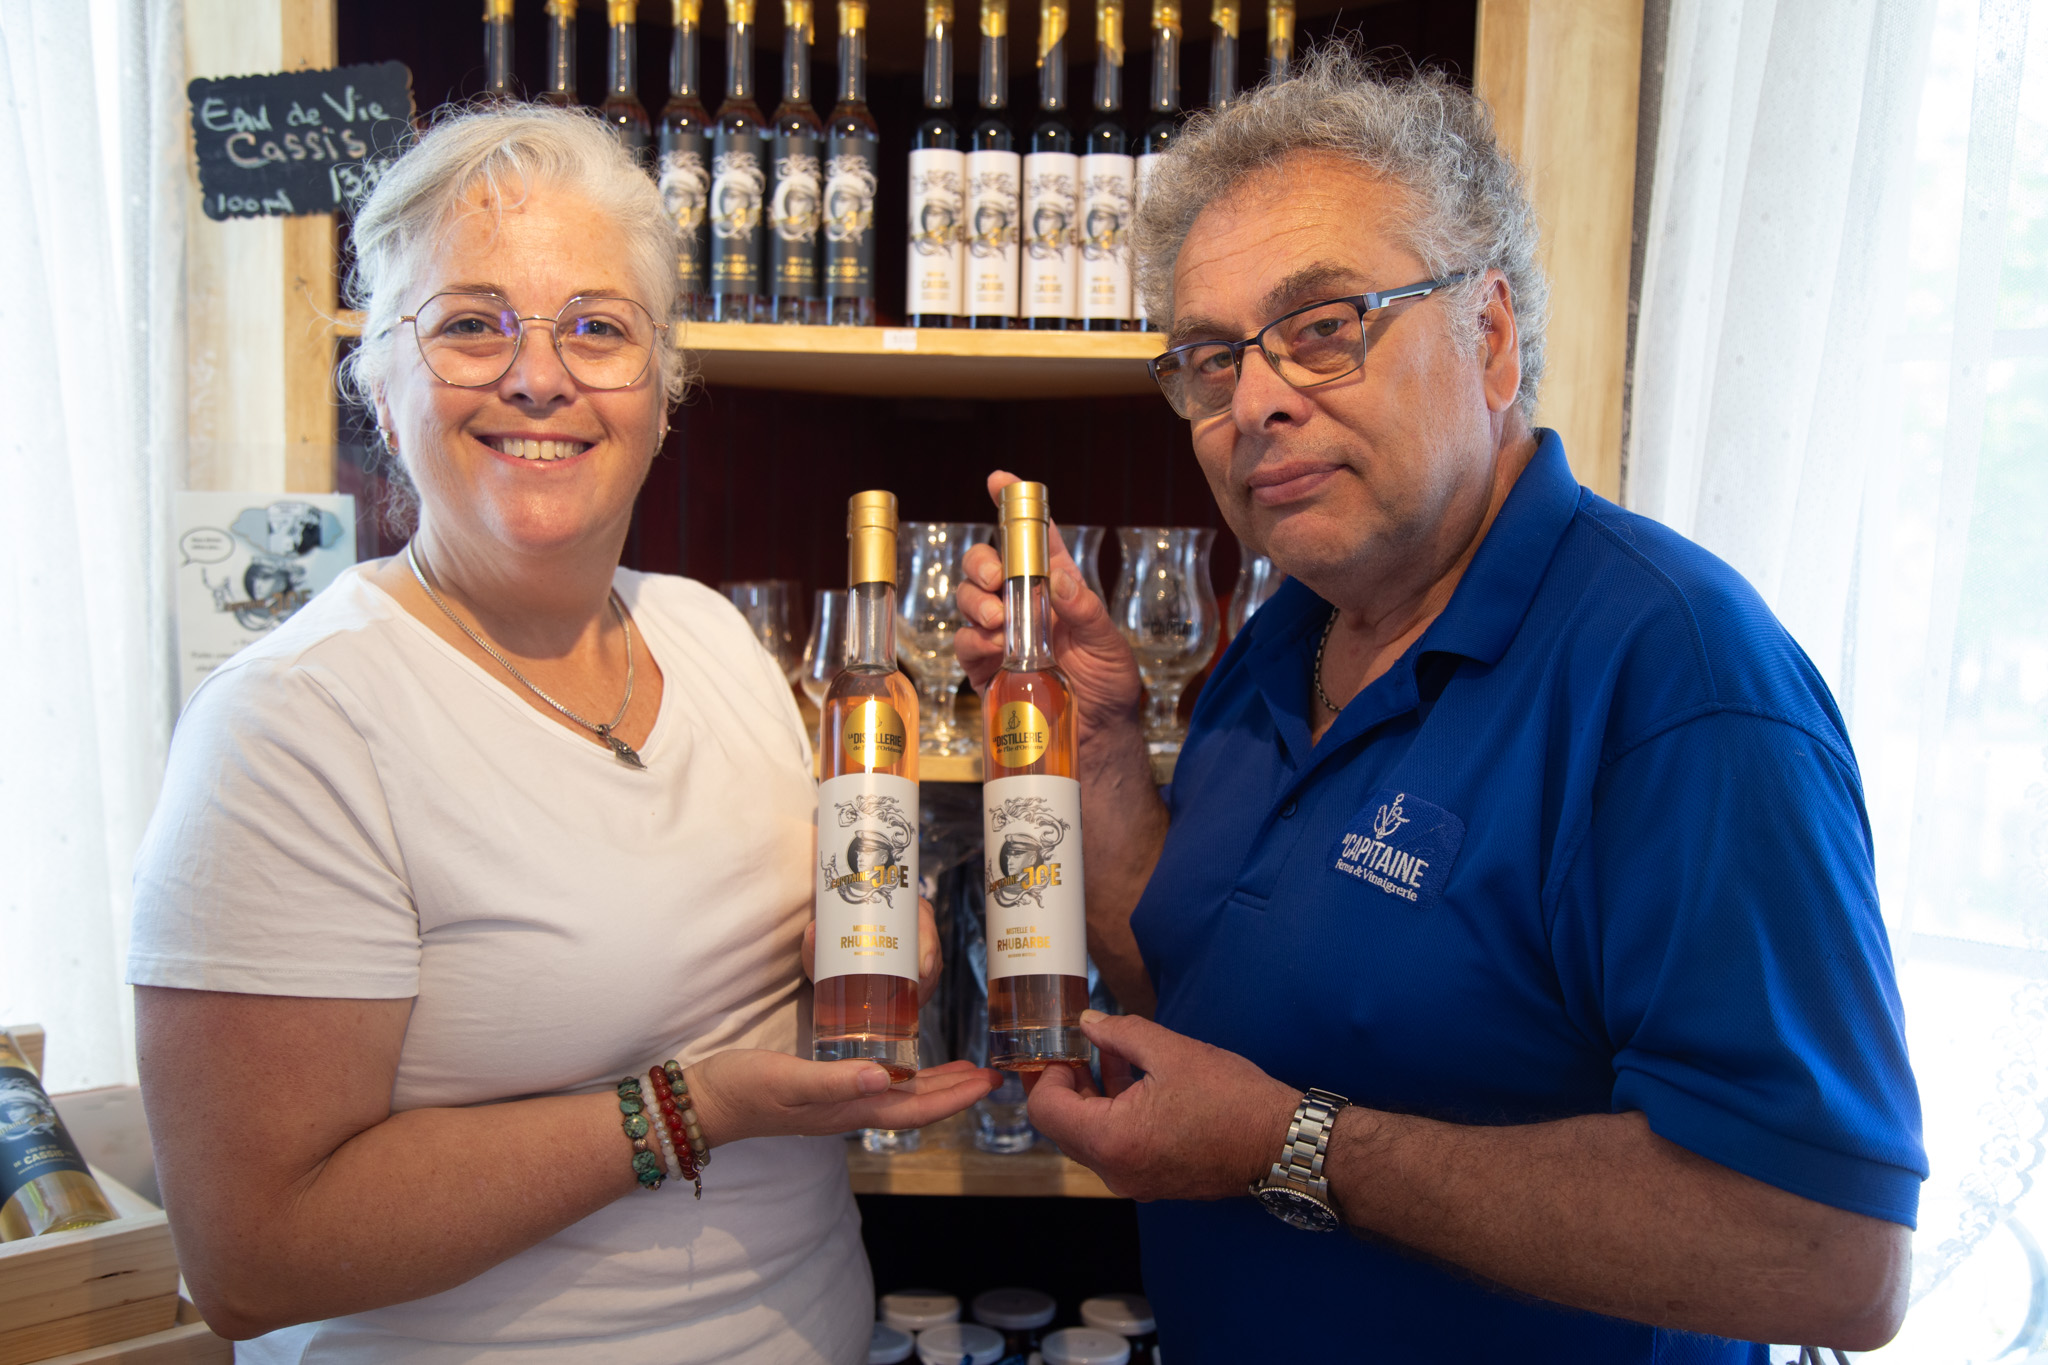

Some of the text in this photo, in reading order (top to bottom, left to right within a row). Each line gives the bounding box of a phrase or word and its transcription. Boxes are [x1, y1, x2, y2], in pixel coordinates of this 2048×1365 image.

[286, 102, 322, 126] de
[322, 85, 390, 122] Vie
[226, 127, 367, 168] Cassis
[853, 732, 902, 748] DISLLERIE
[1343, 832, 1429, 889] CAPITAINE
[871, 864, 909, 888] JOE
[1021, 862, 1062, 890] JOE
[1353, 865, 1363, 878] &
[1363, 868, 1418, 901] Vinaigrerie
[840, 934, 899, 950] RHUBARBE
[997, 935, 1051, 952] RHUBARBE
